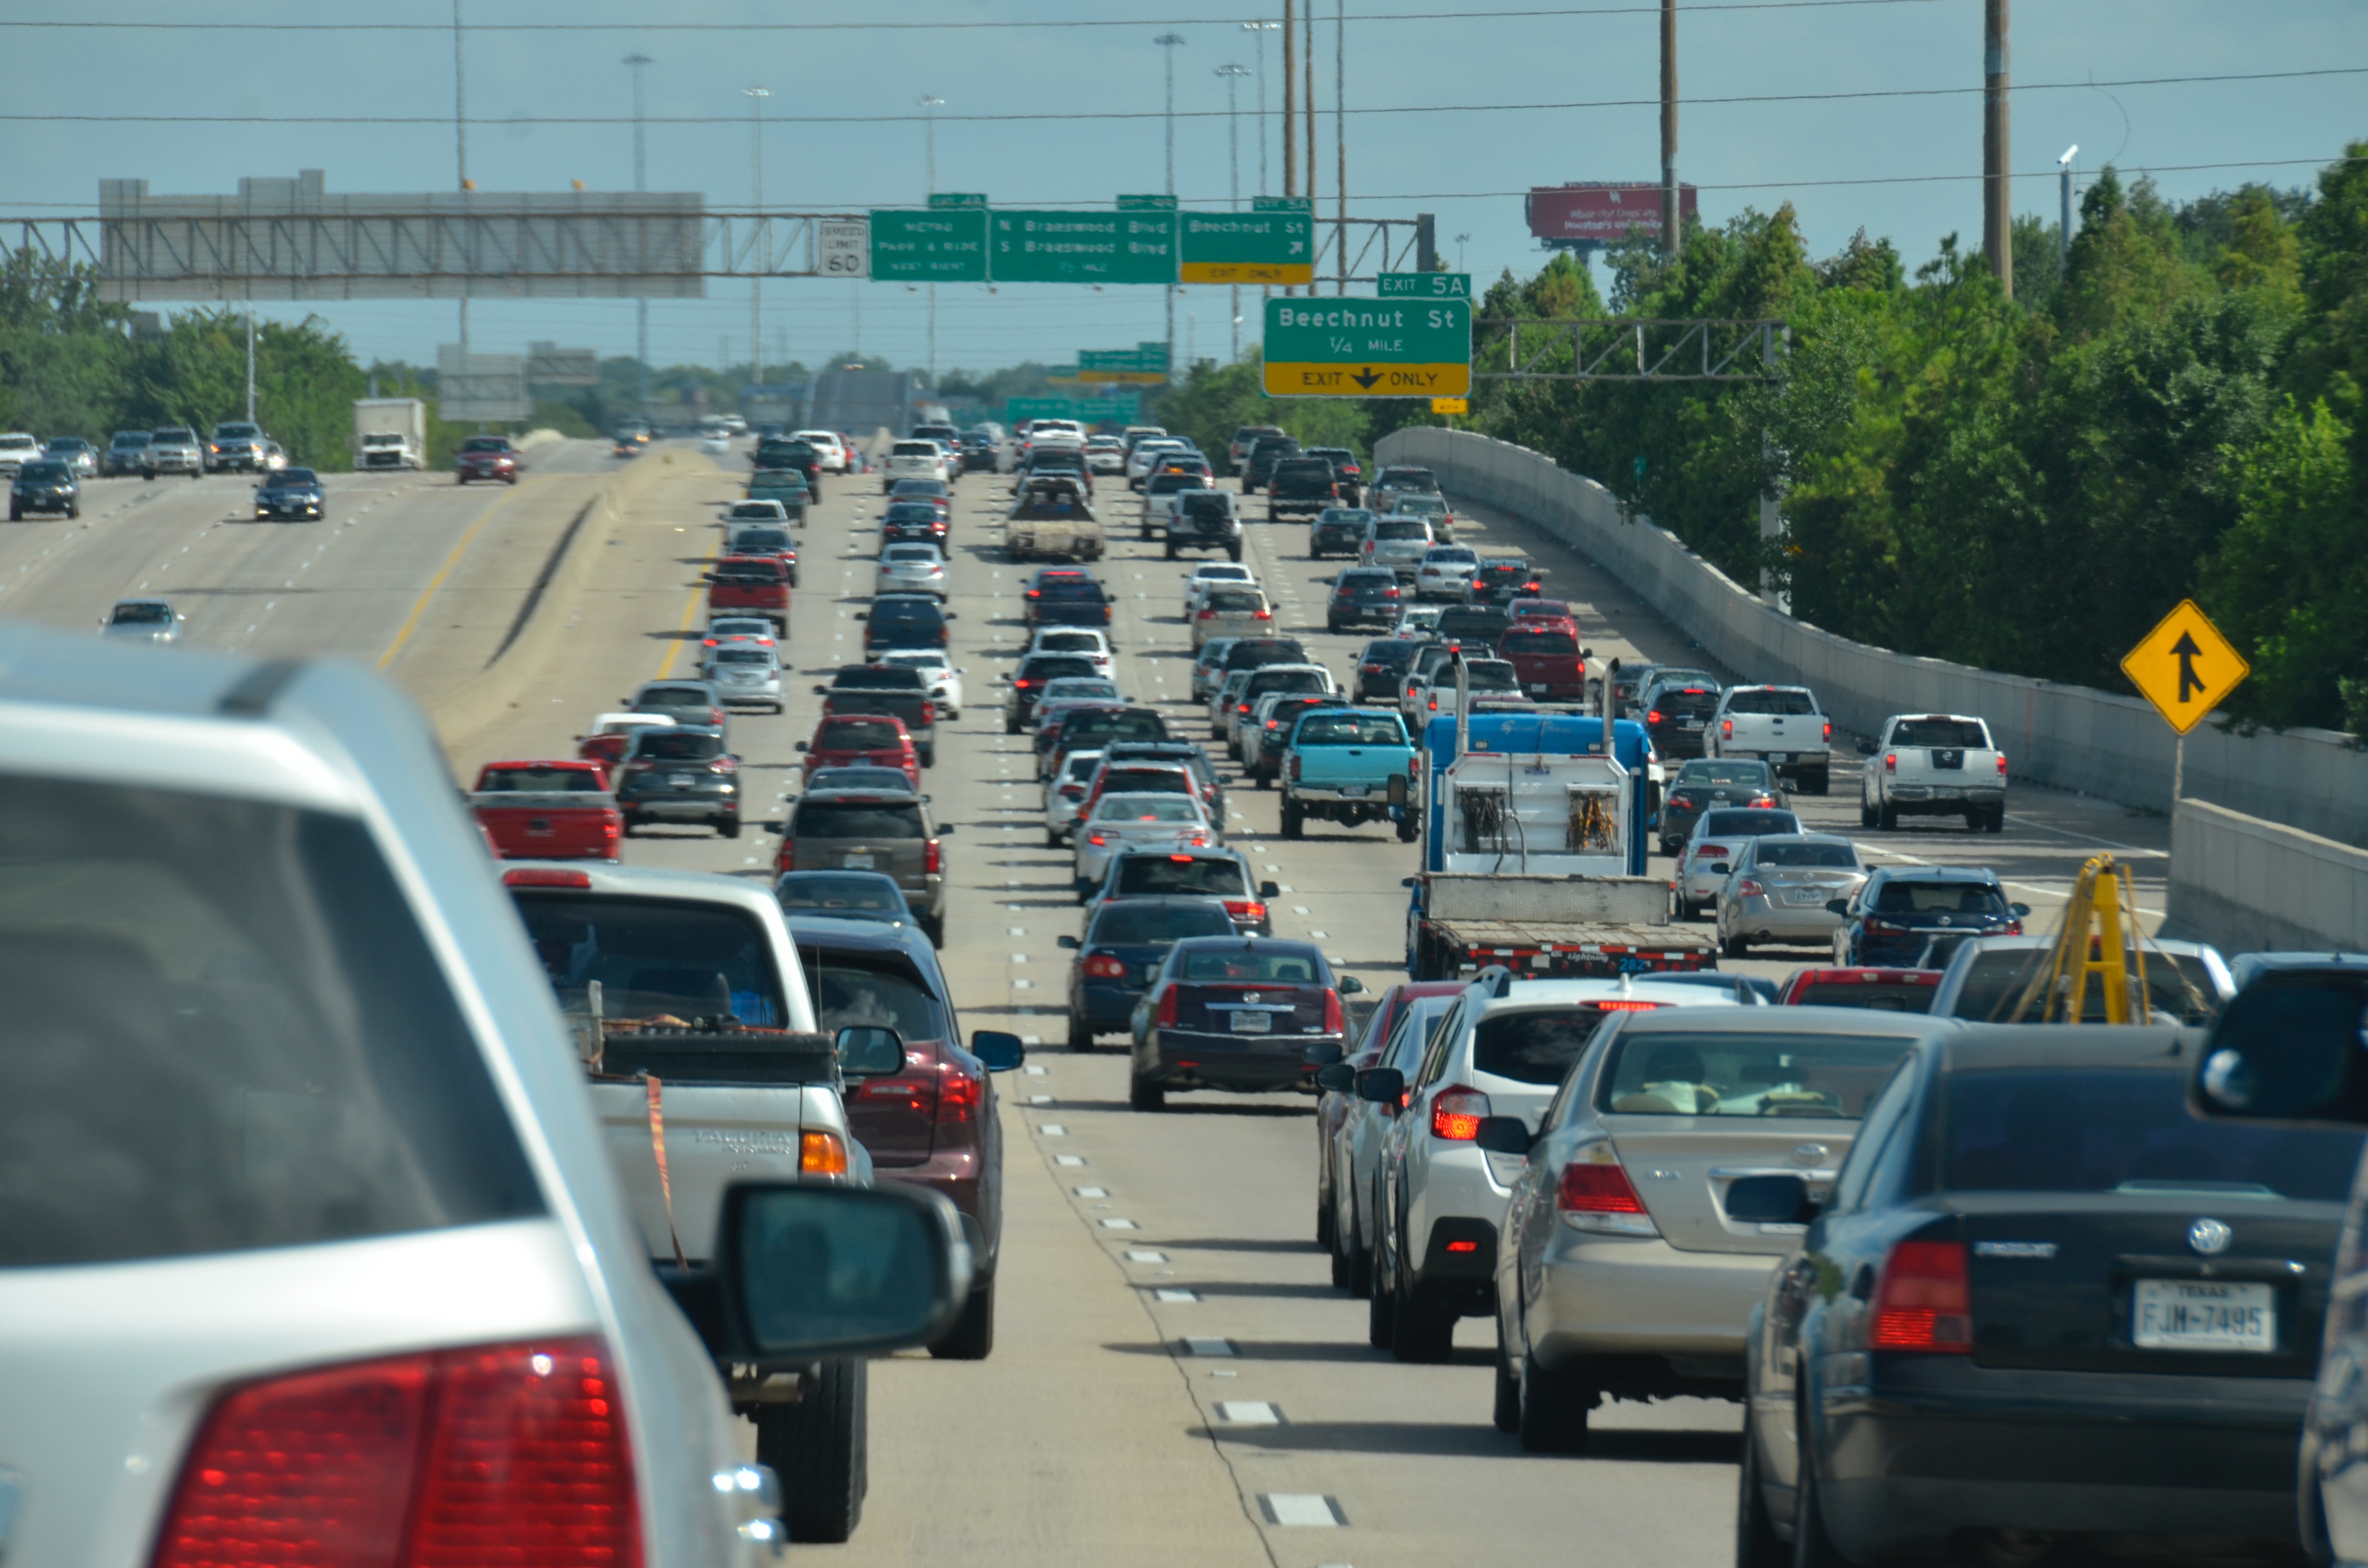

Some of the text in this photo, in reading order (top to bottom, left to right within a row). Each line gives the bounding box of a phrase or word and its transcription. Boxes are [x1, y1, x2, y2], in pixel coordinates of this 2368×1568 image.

[824, 227, 864, 236] SPEED
[904, 222, 953, 233] METRO
[1128, 220, 1168, 234] Blvd
[1189, 220, 1304, 234] Beechnut St
[827, 240, 859, 249] LIMIT
[879, 242, 915, 251] PARK
[943, 242, 979, 251] RIDE
[1001, 241, 1010, 252] S
[1128, 241, 1168, 255] Blvd
[828, 254, 859, 271] 60
[1209, 268, 1282, 280] EXIT ONLY
[1383, 276, 1465, 295] EXIT 5A
[1279, 308, 1455, 329] Beechnut St
[1369, 339, 1403, 352] MILE
[1303, 372, 1438, 386] EXIT ONLY
[1567, 952, 1609, 962] Lightning
[1619, 957, 1645, 971] 282
[693, 1130, 790, 1144] TACOMA
[2178, 1286, 2230, 1298] TEXAS
